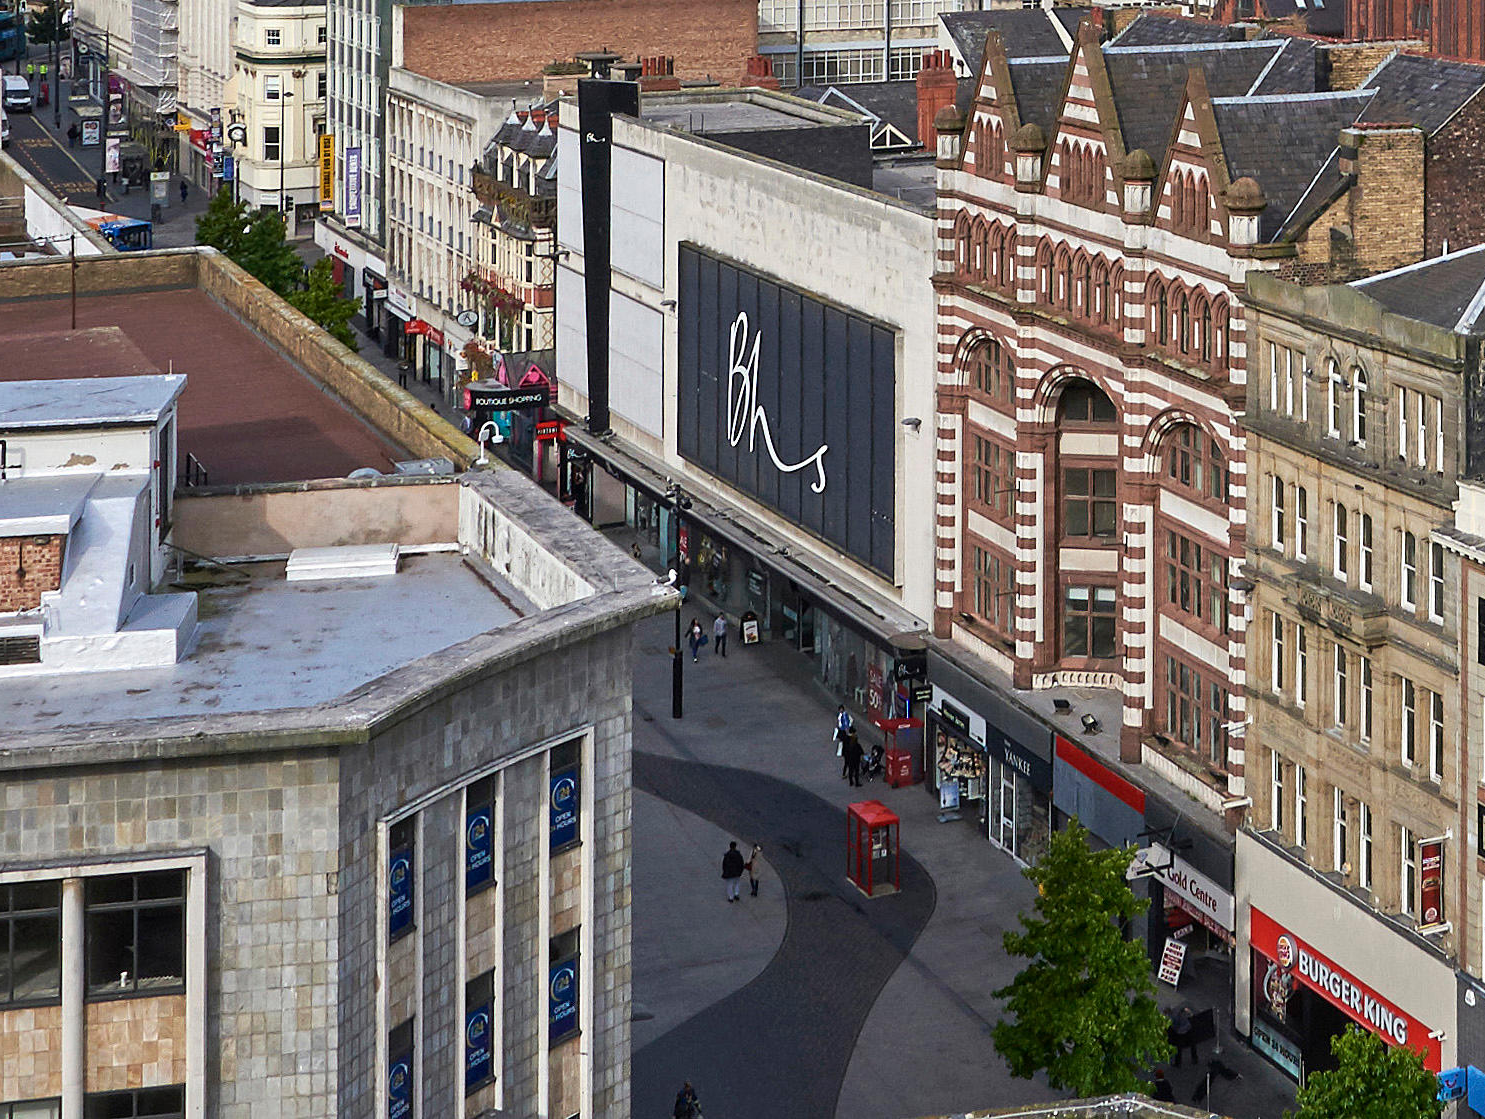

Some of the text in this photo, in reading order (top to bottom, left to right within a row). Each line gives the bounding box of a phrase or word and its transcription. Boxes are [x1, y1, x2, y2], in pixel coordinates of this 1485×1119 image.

[475, 394, 542, 406] BOUTIQUE SHOPPING
[727, 311, 829, 493] Bhs
[1003, 746, 1032, 777] YANKEE
[555, 810, 572, 822] OPEN
[556, 816, 576, 830] HOURS
[469, 849, 485, 863] OPEN
[471, 854, 491, 870] HOURS
[1166, 866, 1188, 890] Gold
[1189, 879, 1218, 913] Centre
[391, 894, 405, 909] OPEN
[392, 899, 410, 915] HOURS
[1297, 949, 1364, 1014] BURGER
[1363, 994, 1408, 1046] KING
[553, 1000, 570, 1013] OPEN
[555, 1006, 576, 1021] HOURS
[1253, 1026, 1271, 1046] OPEN
[469, 1047, 484, 1060] OPEN
[470, 1051, 490, 1068] HOURS
